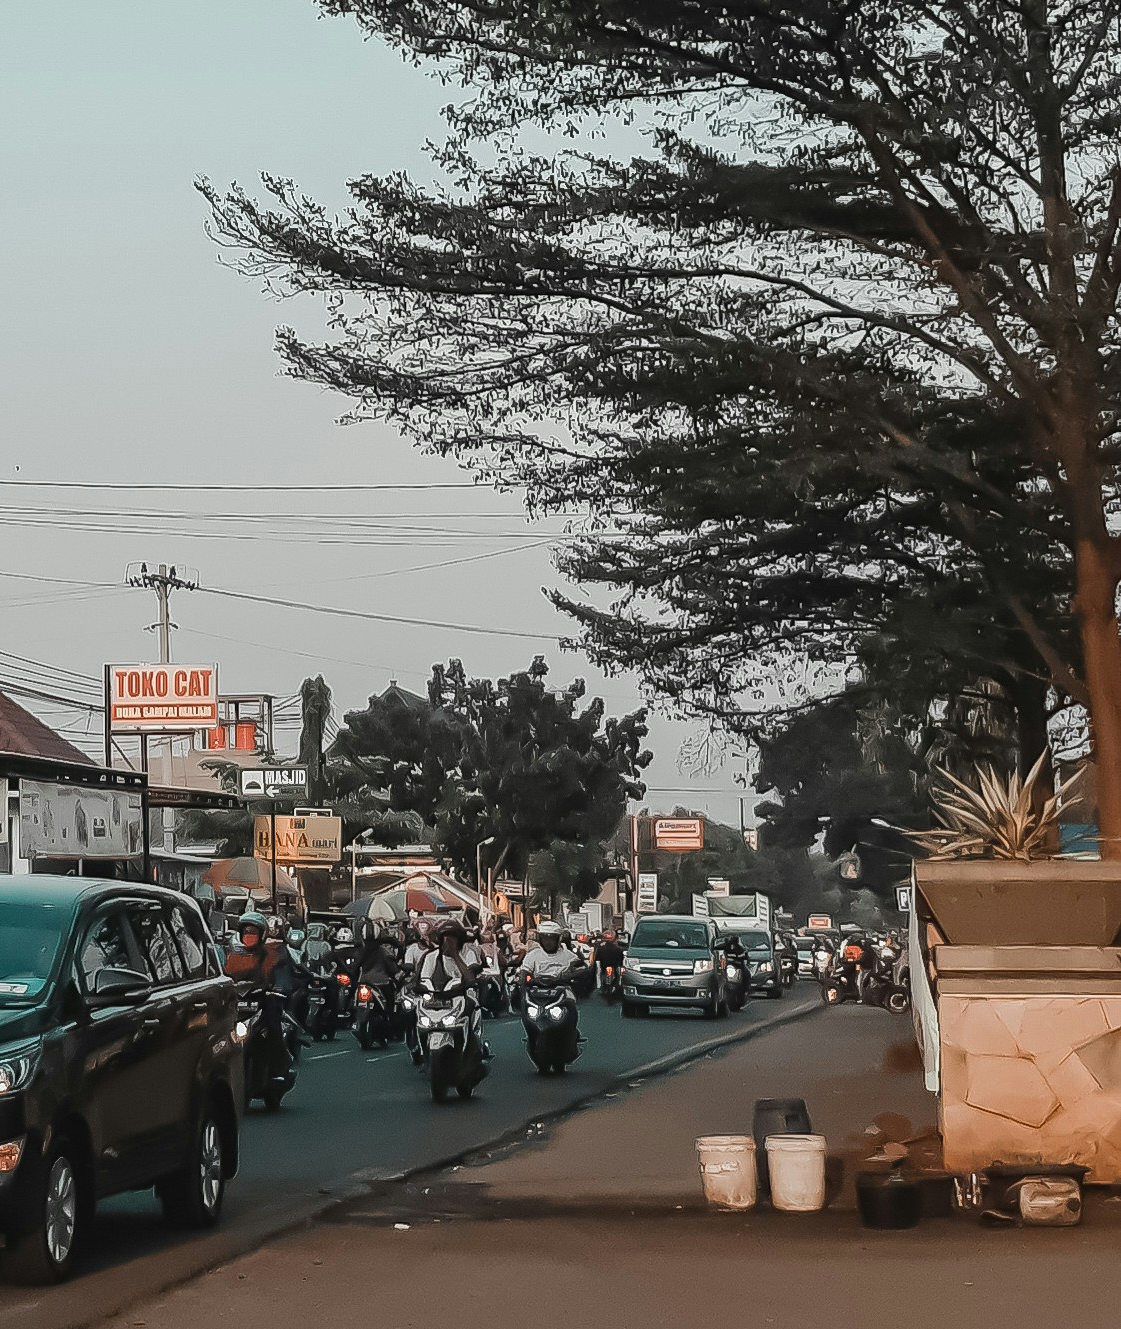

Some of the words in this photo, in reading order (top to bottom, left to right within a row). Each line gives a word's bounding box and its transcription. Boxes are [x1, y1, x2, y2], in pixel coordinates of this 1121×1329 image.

[115, 670, 168, 698] TOKO
[174, 669, 212, 697] CAT
[264, 769, 306, 785] MASJID
